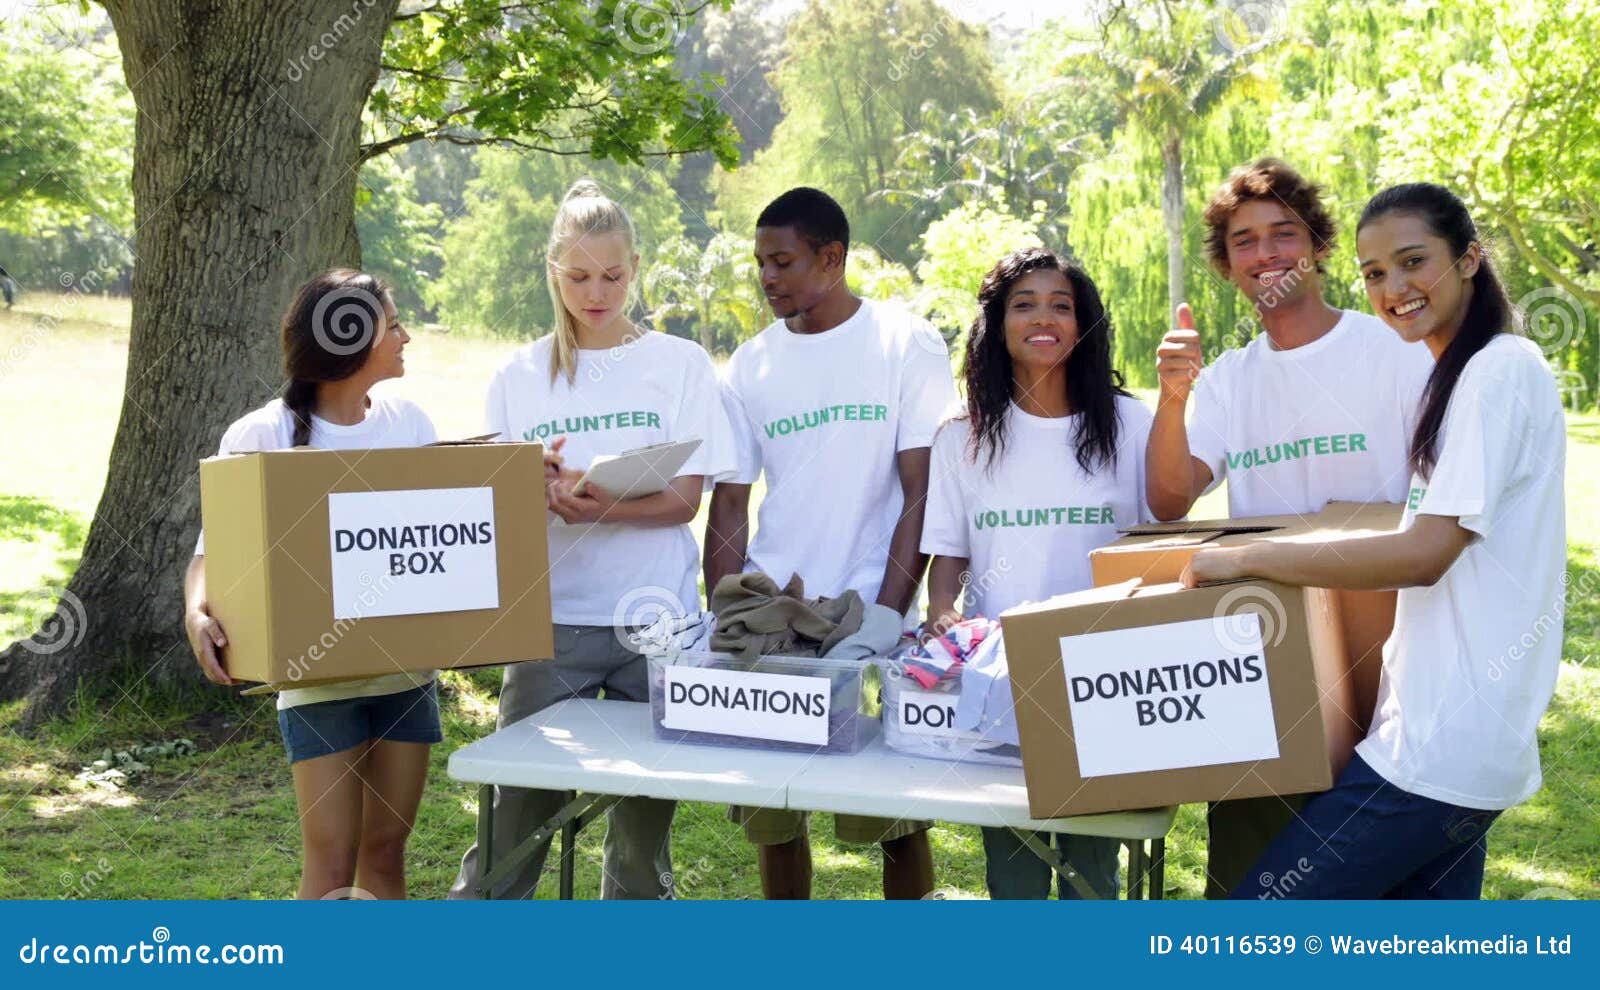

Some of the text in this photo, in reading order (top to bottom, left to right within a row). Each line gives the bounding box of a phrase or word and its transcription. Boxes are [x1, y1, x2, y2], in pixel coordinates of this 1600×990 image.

[523, 410, 661, 442] VOLUNTEER
[764, 404, 888, 439] VOLUNTEER
[1225, 433, 1368, 470] VOLUNTEER
[974, 506, 1115, 530] VOLUNTEER
[334, 521, 492, 553] DONATIONS
[389, 551, 446, 577] BOX
[1071, 654, 1264, 703] DONATIONS
[670, 680, 826, 718] DONATIONS
[1135, 693, 1206, 727] BOX
